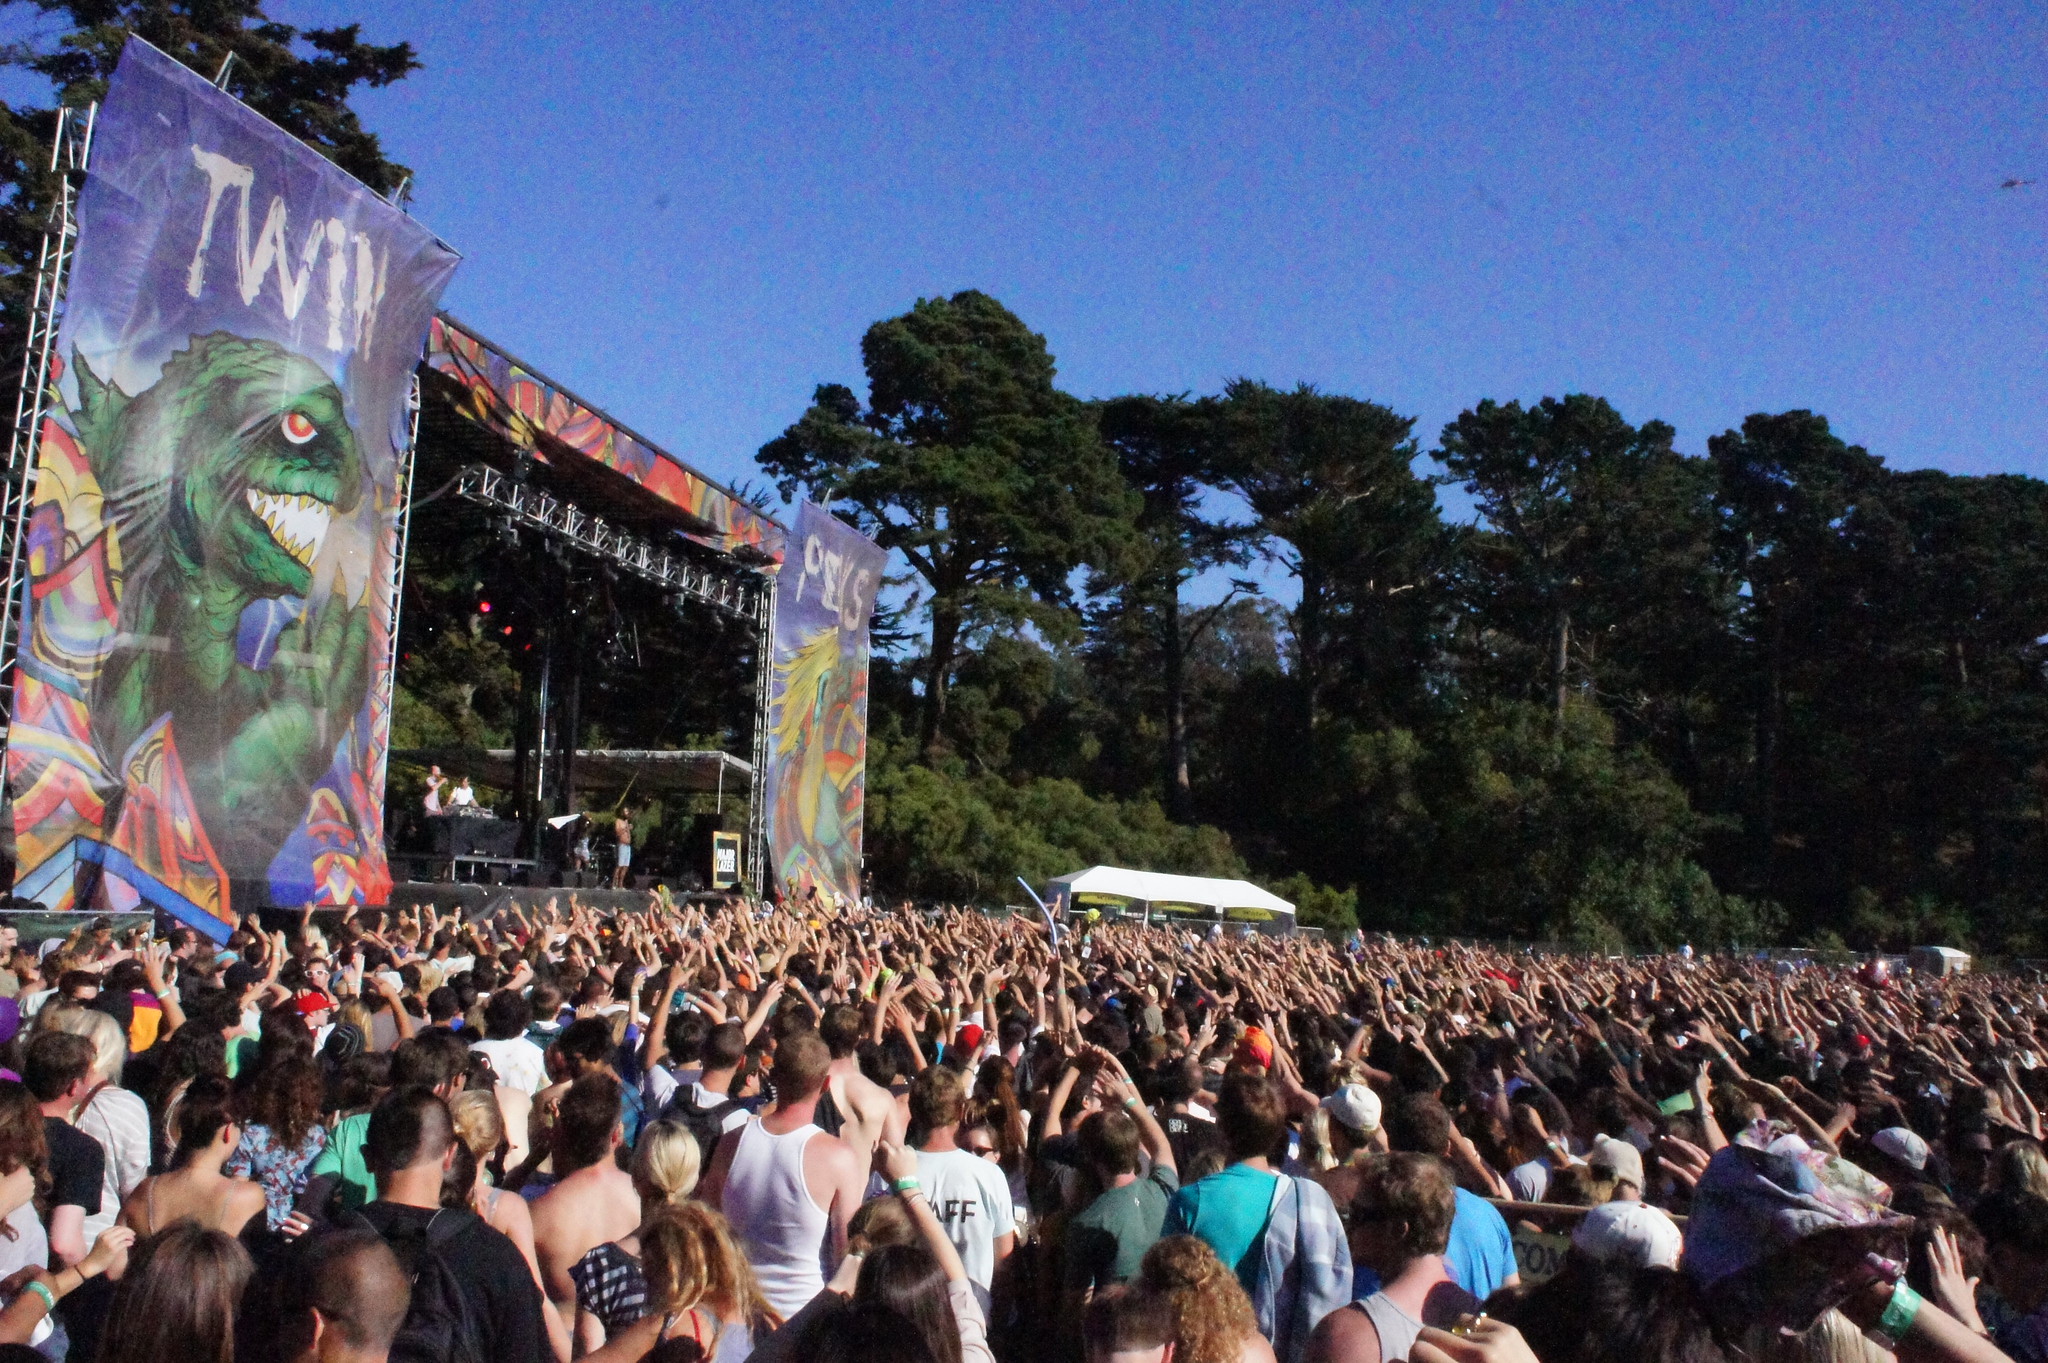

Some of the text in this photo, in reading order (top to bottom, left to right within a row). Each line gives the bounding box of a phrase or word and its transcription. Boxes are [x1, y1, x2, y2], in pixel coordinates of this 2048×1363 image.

[717, 848, 735, 860] MAJOR
[717, 860, 735, 872] LAZER
[929, 1200, 977, 1224] AFF
